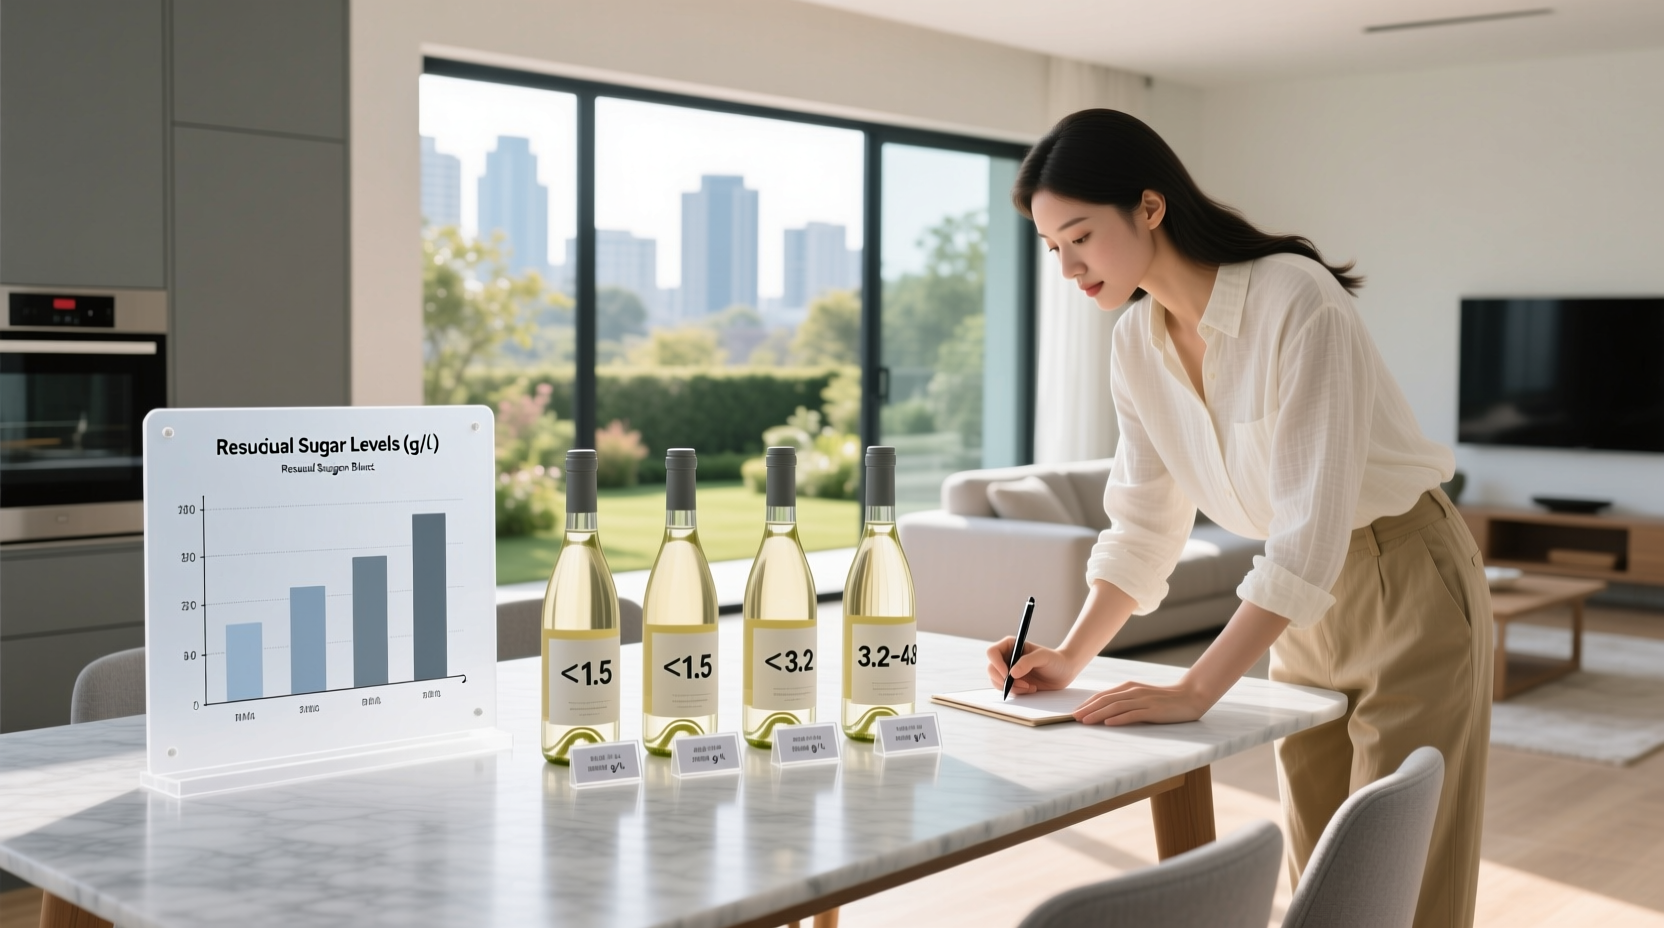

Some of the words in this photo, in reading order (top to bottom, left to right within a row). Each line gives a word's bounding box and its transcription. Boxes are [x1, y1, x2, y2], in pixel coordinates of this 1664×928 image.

[298, 437, 347, 458] Sugar
[350, 434, 401, 453] Levels
[560, 659, 613, 686] <1.5
[663, 653, 713, 680] <1.5
[764, 648, 814, 673] <3.2
